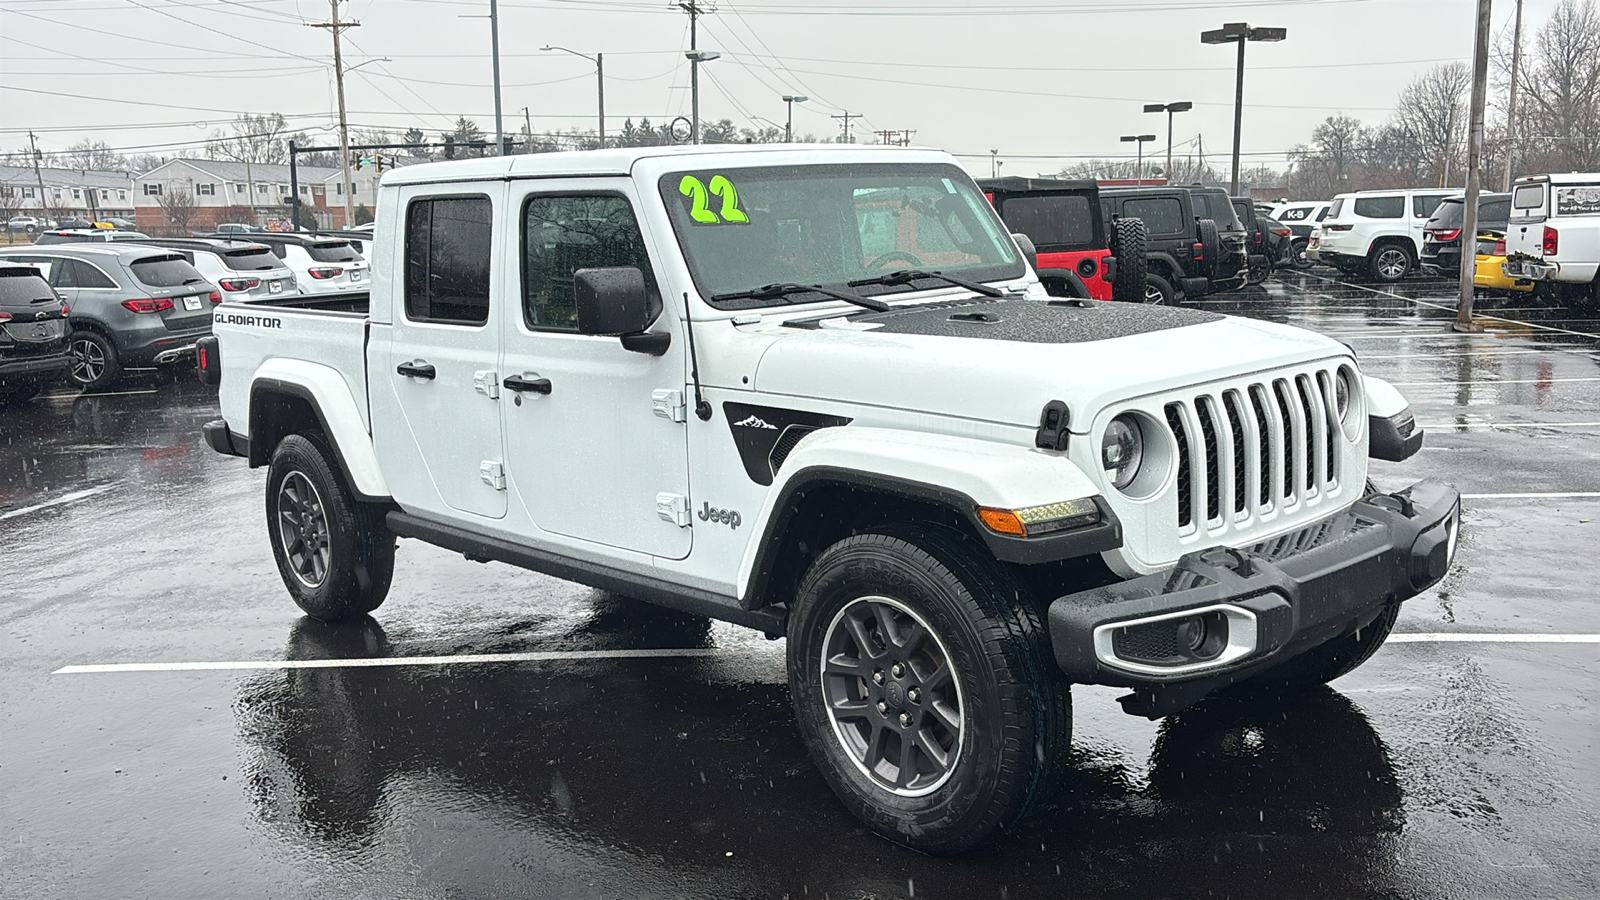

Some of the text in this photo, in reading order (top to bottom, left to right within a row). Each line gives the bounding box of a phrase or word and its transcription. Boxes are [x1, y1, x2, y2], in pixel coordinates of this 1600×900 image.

[679, 175, 750, 224] 22
[1287, 210, 1304, 219] K-9
[215, 313, 282, 329] GLADIATOR
[698, 501, 742, 530] Jeep
